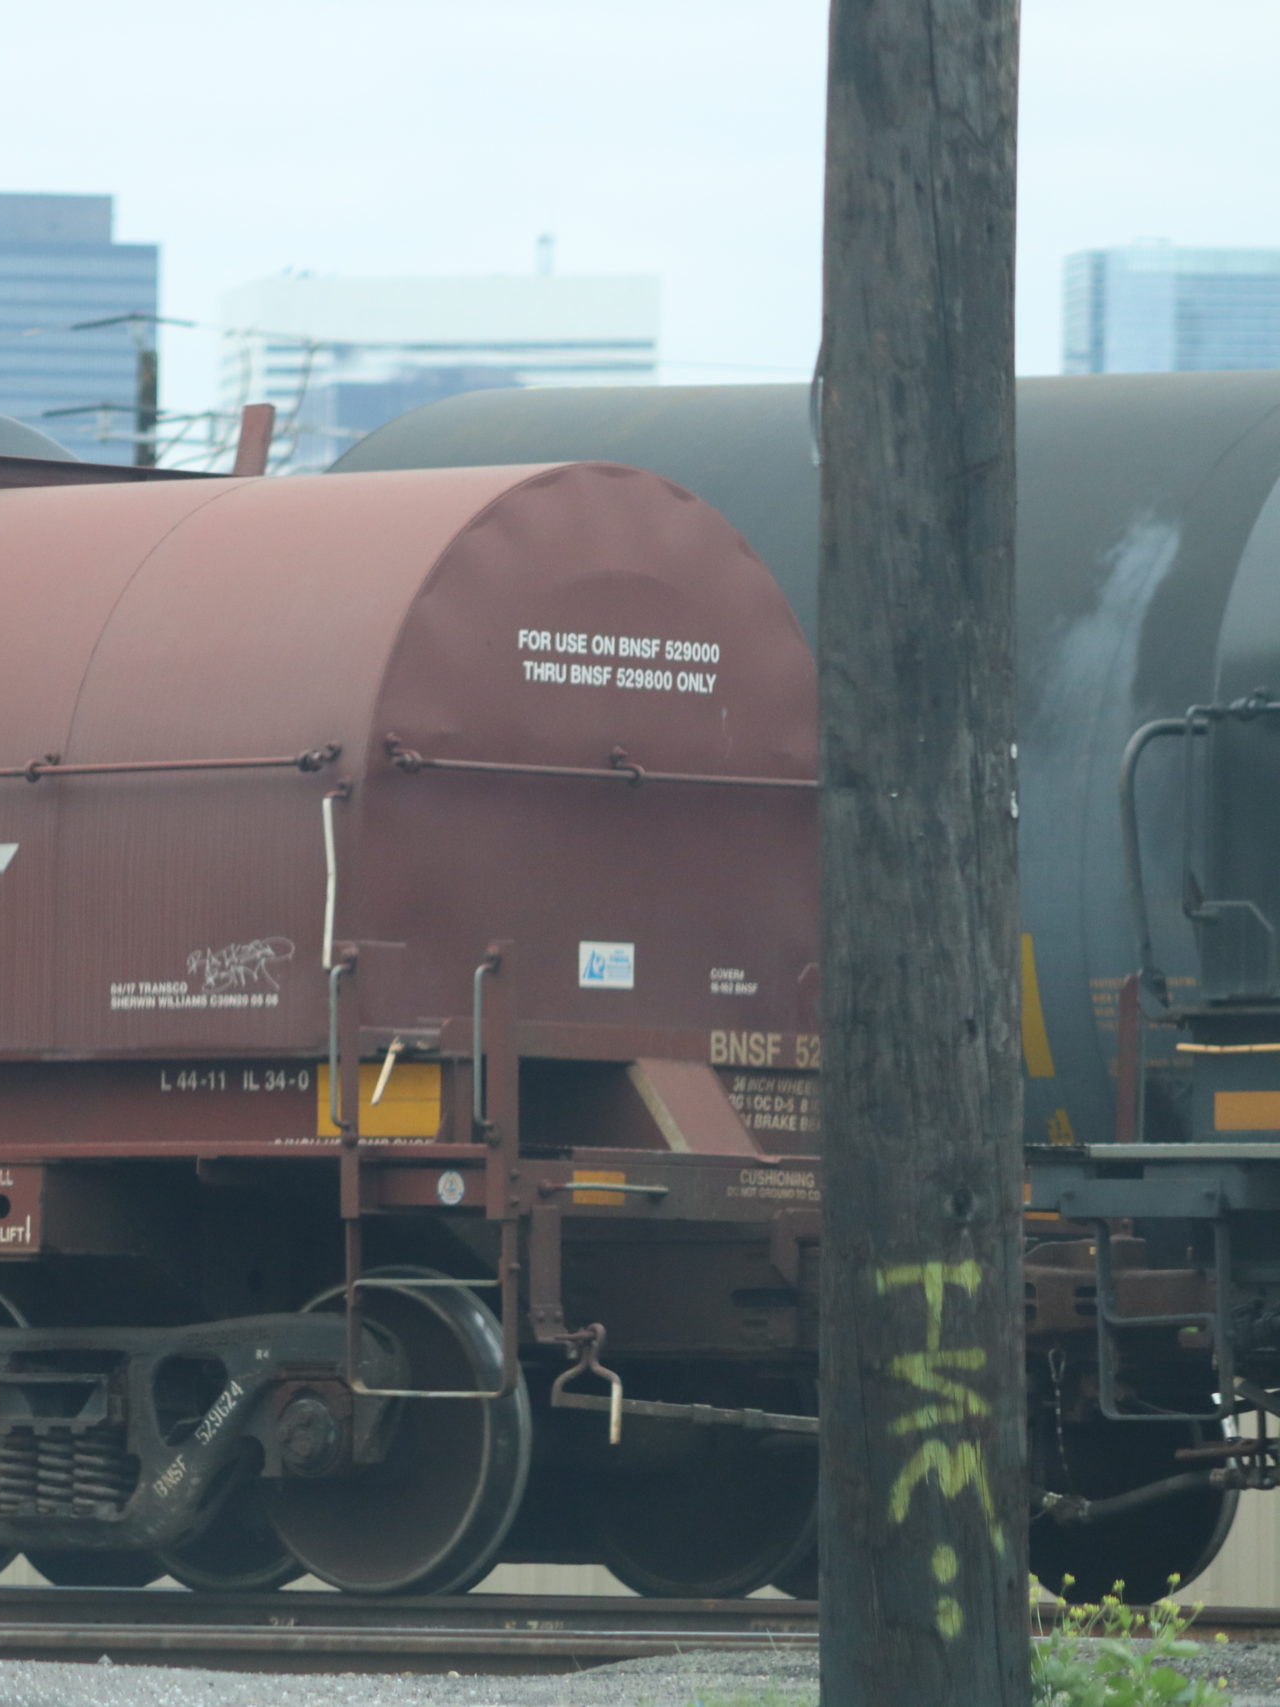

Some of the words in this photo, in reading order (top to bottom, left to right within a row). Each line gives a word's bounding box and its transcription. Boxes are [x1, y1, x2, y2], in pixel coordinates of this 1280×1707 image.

[518, 630, 552, 651] FOR
[555, 633, 588, 654] USE
[592, 635, 616, 656] ON
[619, 637, 661, 659] BNSF
[665, 640, 720, 663] 529000
[523, 661, 567, 683] THRU
[570, 664, 612, 686] BNSF
[616, 667, 673, 690] 529800
[677, 671, 717, 694] ONLY
[138, 980, 188, 995] TRANSCO
[111, 995, 156, 1009] SHERWIN
[158, 994, 207, 1009] WILLIAMS
[709, 1030, 783, 1067] BNSF
[795, 1033, 821, 1069] 52
[161, 1069, 172, 1092] L
[176, 1069, 227, 1092] 44-11
[243, 1069, 260, 1092] IL
[264, 1069, 309, 1092] 34-0
[753, 1112, 798, 1132] BRAKE
[739, 1168, 817, 1189] CUSHIONING
[153, 1453, 188, 1498] BNSF
[194, 1379, 245, 1446] 529624
